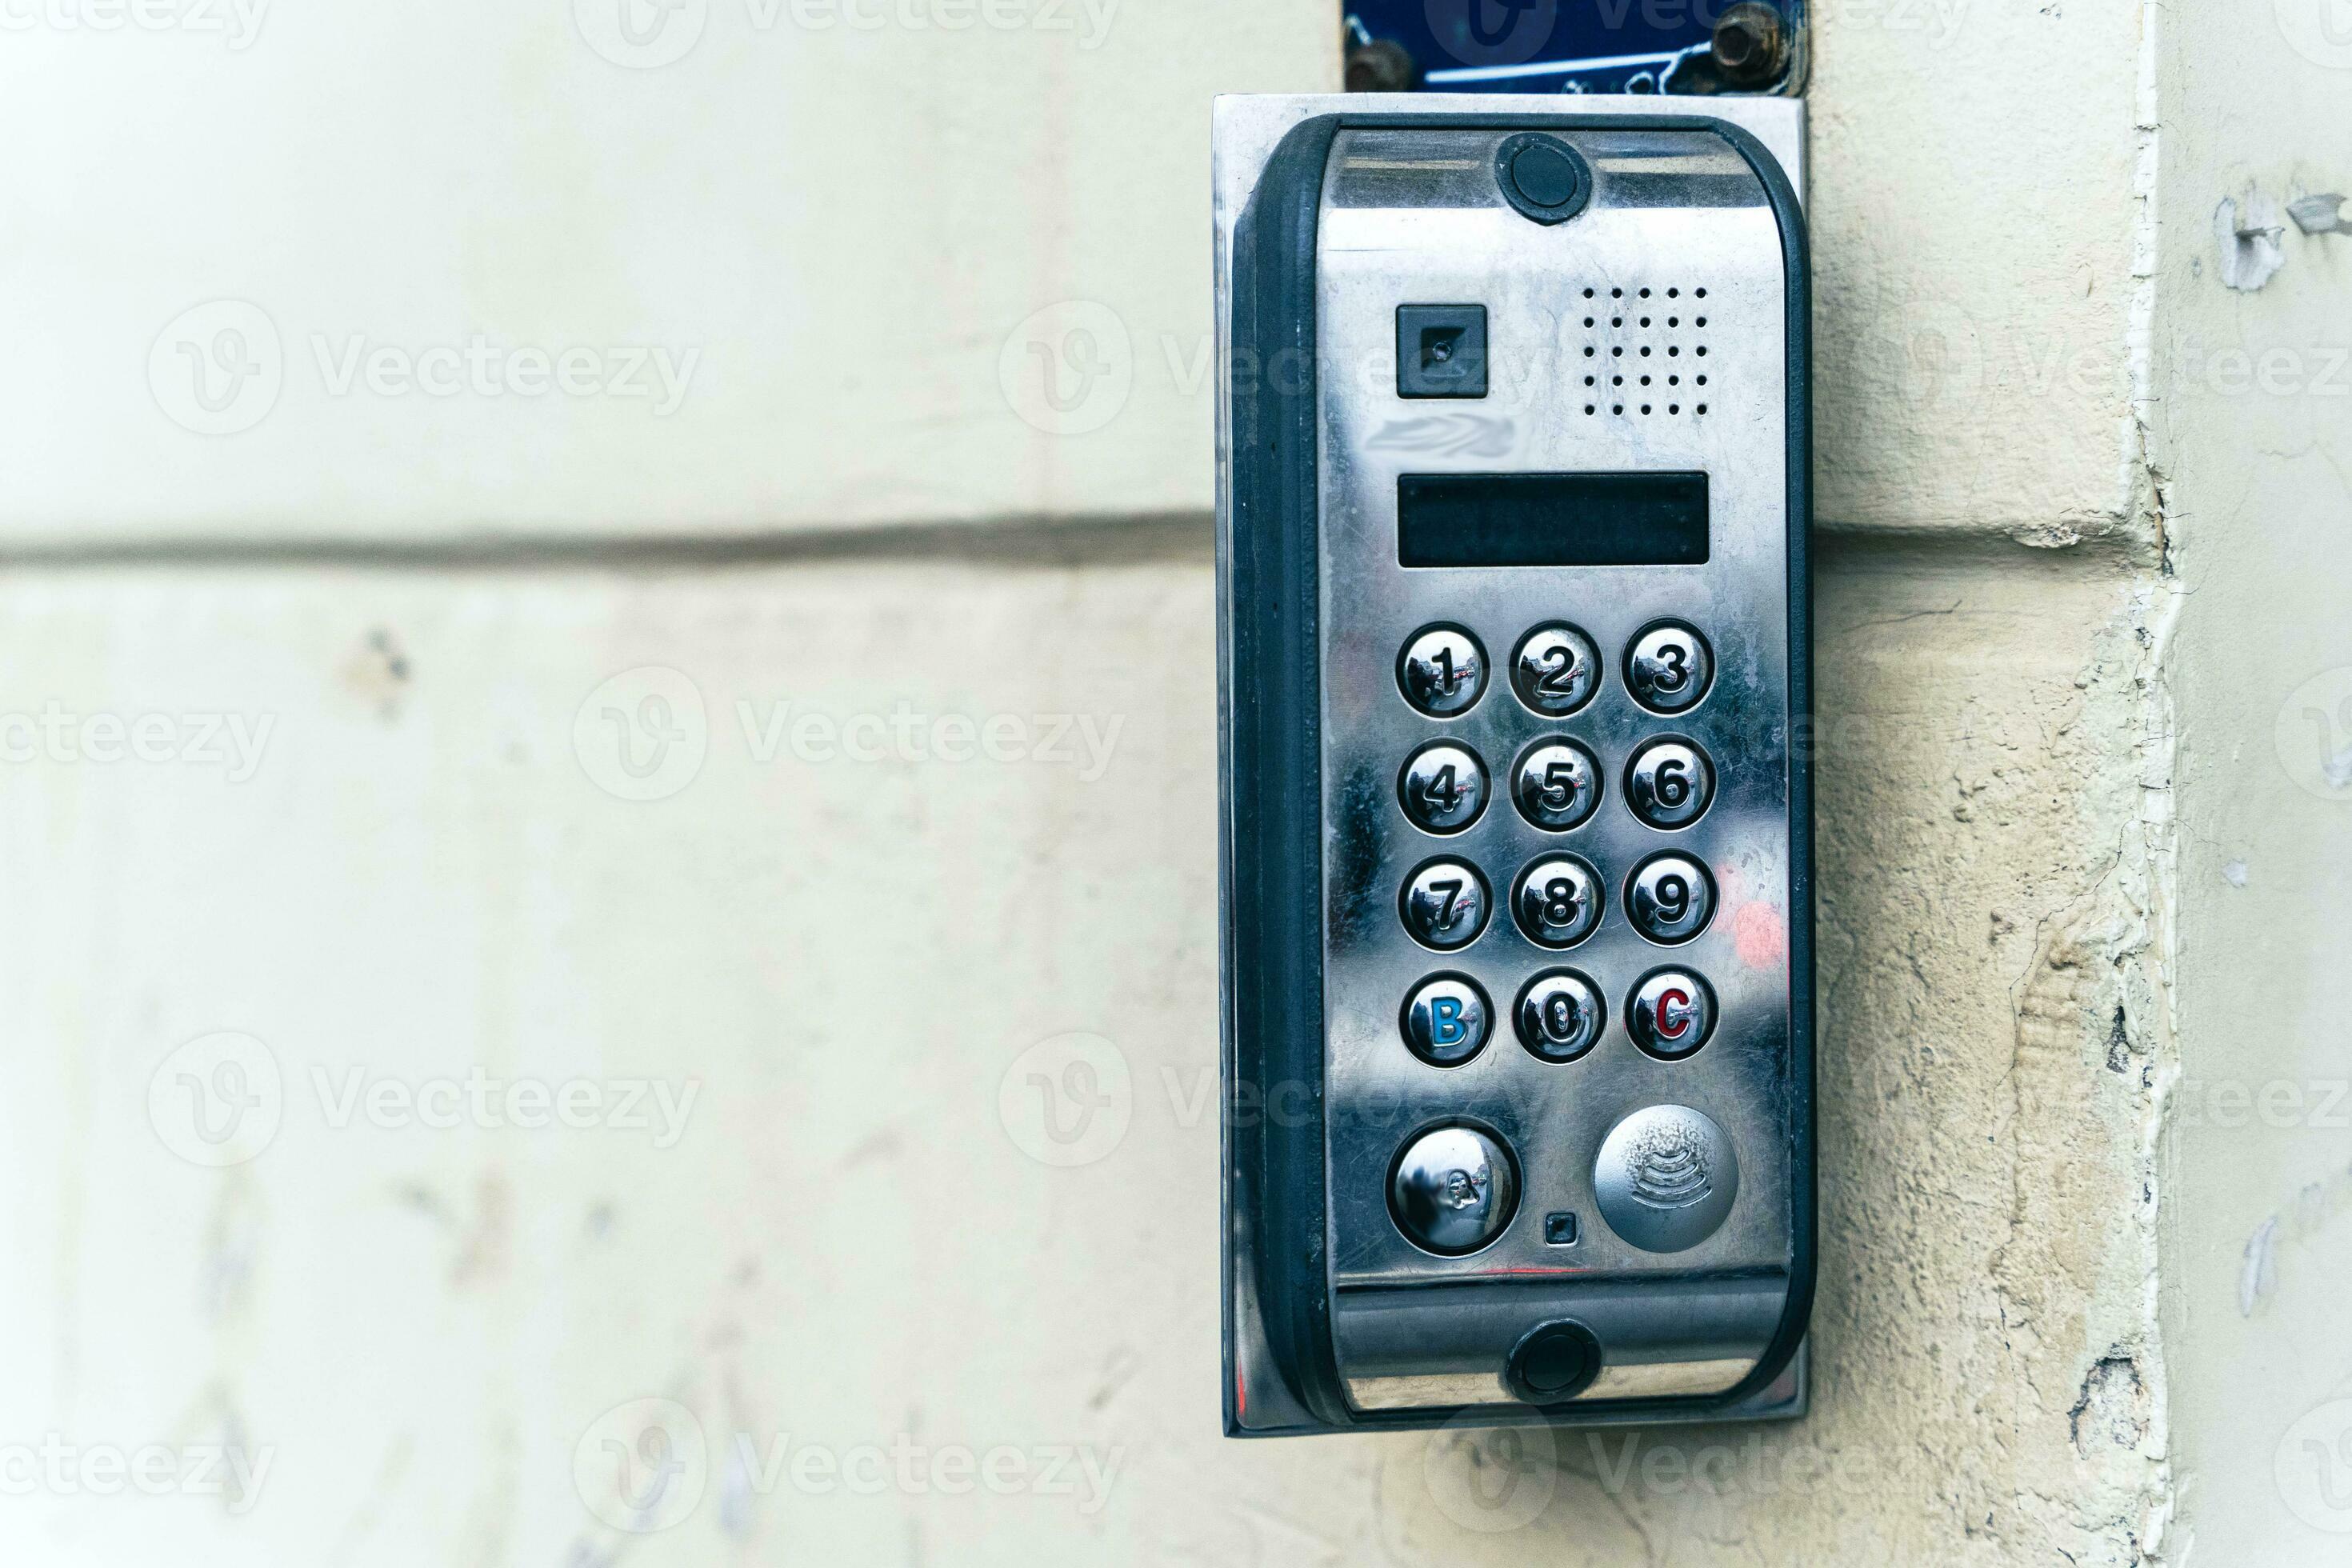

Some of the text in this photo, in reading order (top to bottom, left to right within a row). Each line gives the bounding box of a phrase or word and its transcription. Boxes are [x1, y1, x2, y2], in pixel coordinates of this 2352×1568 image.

[1433, 644, 1688, 696] 1 2 3
[1424, 760, 1690, 813] 4 5 6
[1429, 875, 1689, 930] 7 8 9
[1430, 988, 1690, 1047] B 0 C
